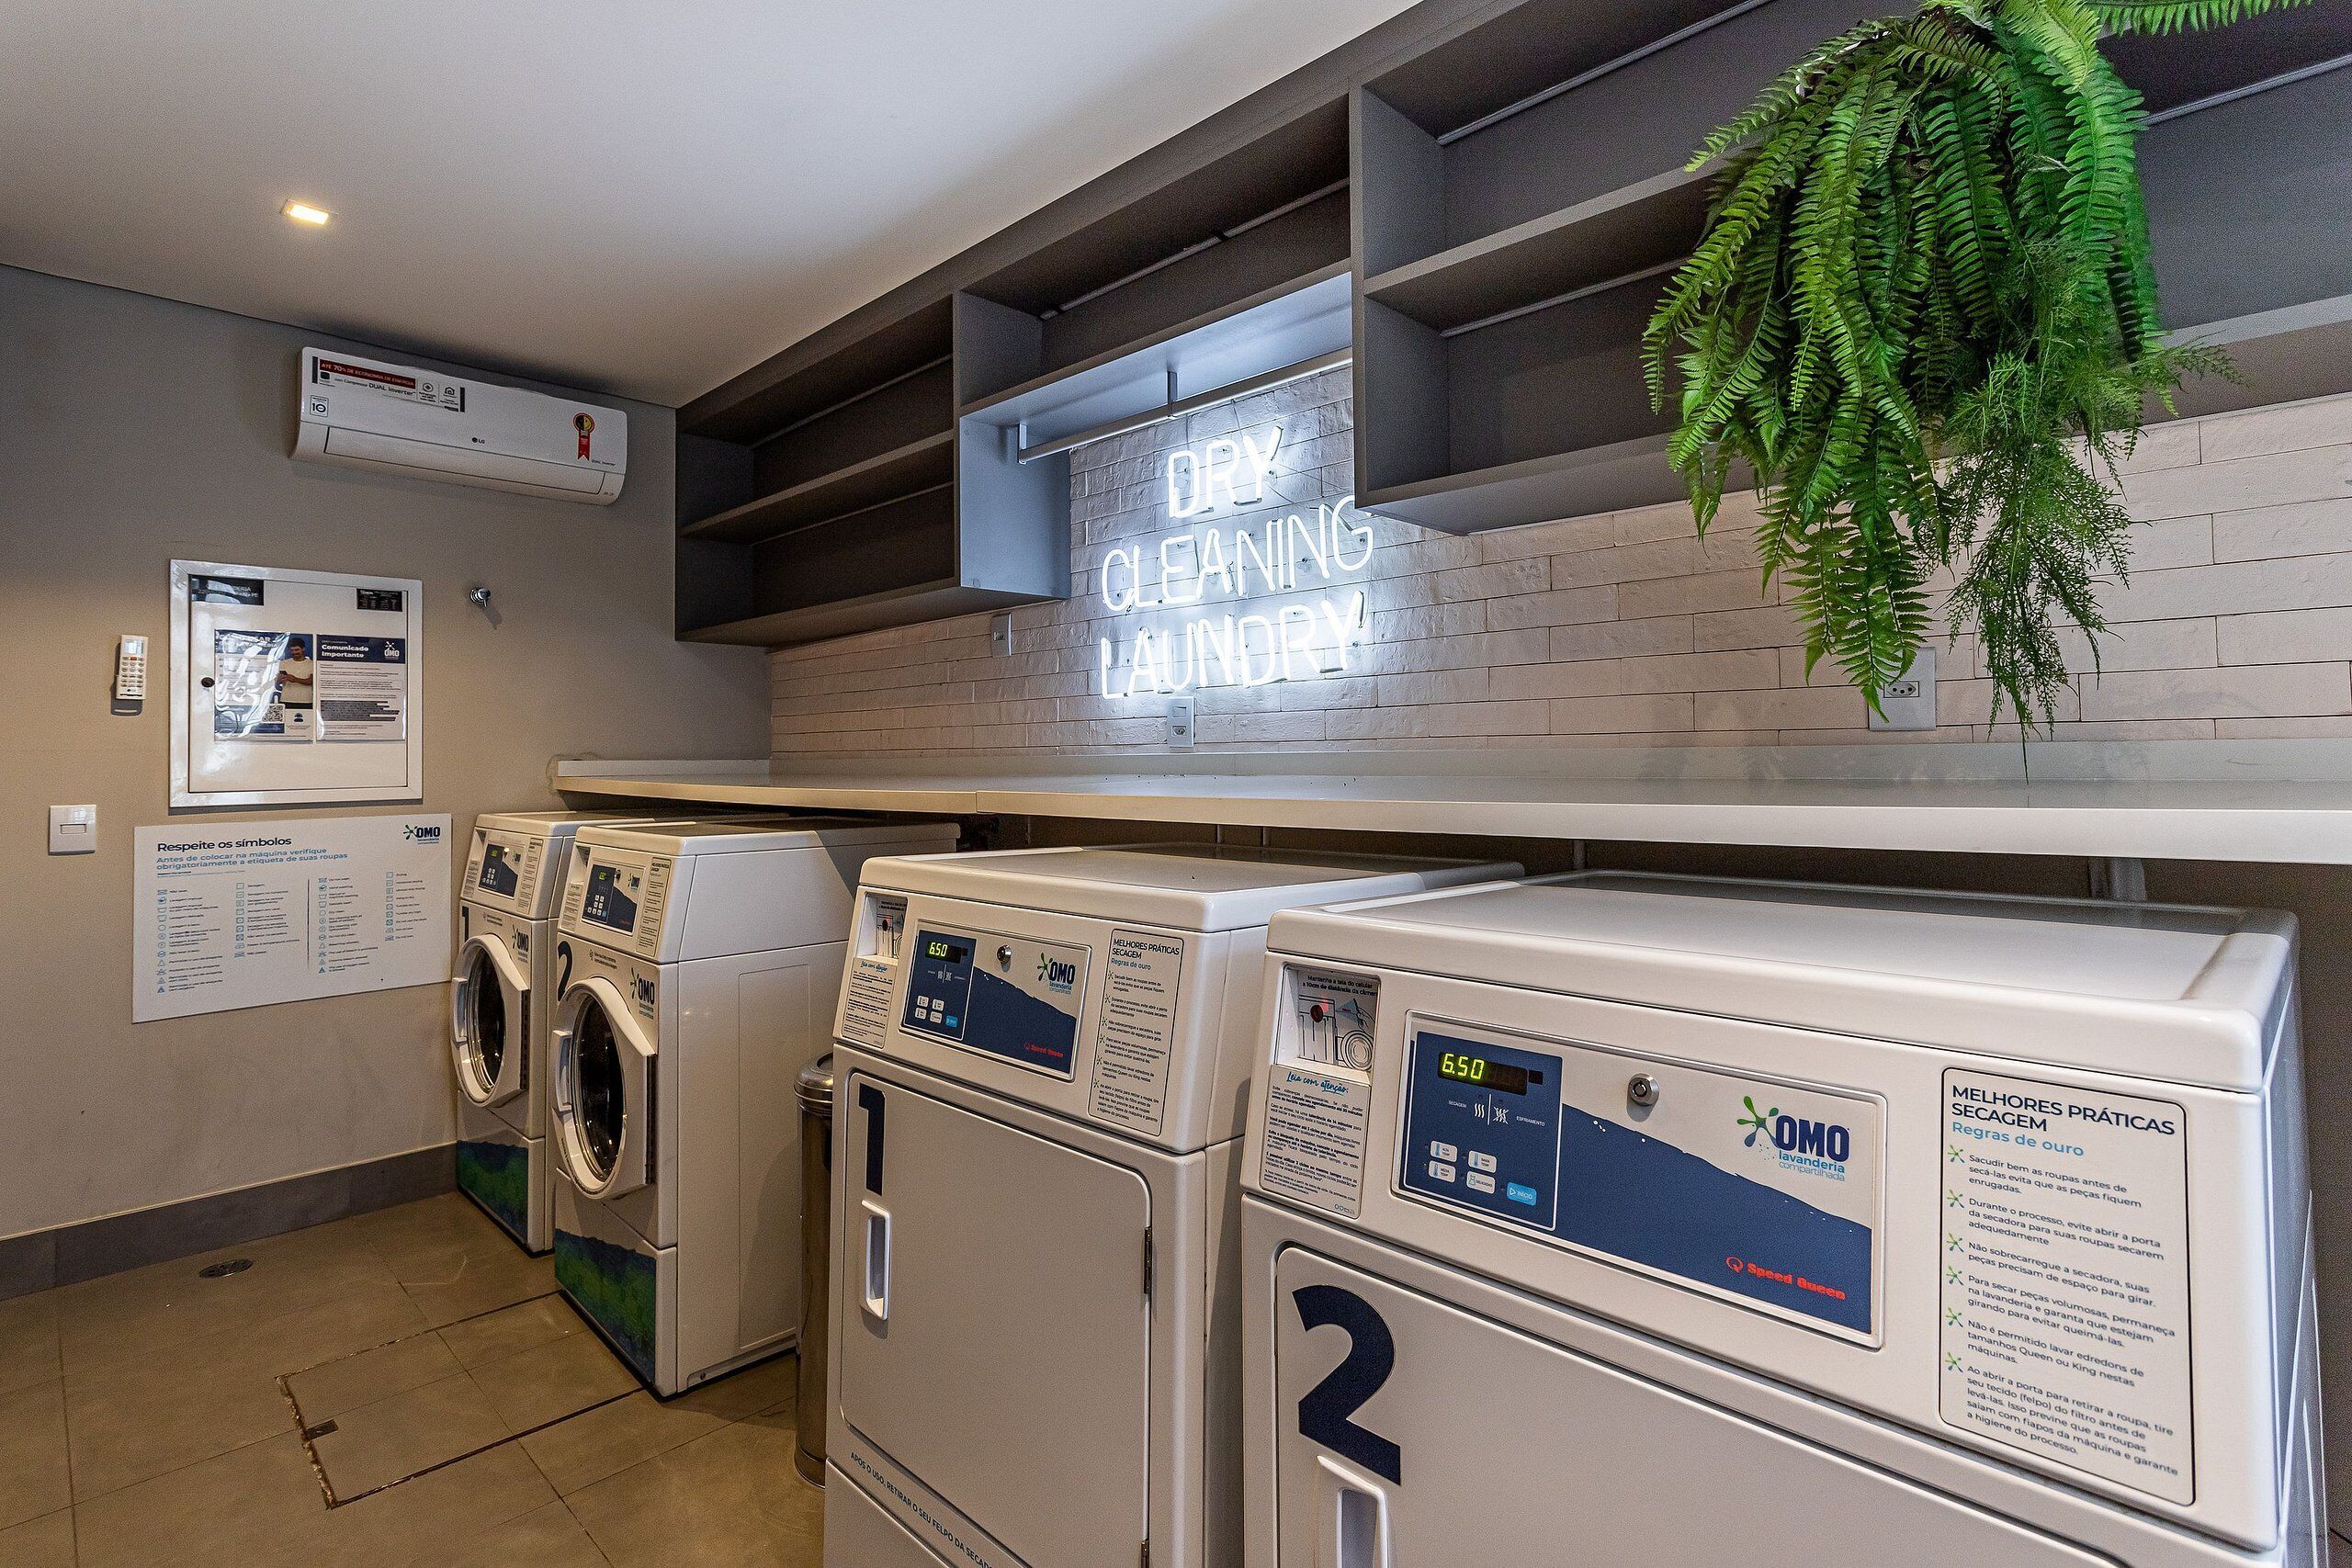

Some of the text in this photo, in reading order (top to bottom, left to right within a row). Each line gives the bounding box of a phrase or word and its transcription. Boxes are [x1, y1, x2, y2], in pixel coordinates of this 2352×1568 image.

[368, 382, 387, 391] DUAL
[1167, 423, 1284, 519] DRY
[1102, 494, 1374, 613] CLEANING
[322, 644, 369, 652] Comunicado
[322, 651, 365, 660] Importante
[384, 649, 400, 658] OMO
[1101, 590, 1365, 700] LAUNDRY
[157, 837, 292, 852] Respeite os símbolos
[416, 826, 441, 838] OMO
[156, 855, 184, 863] Antes
[199, 852, 233, 861] colocar
[249, 849, 288, 859] máquina
[289, 847, 327, 856] verifique
[156, 859, 237, 871] obrigatoriamente
[247, 856, 284, 865] etiqueta
[320, 852, 348, 862] roupas
[1111, 957, 1130, 967] Regras
[1112, 947, 1142, 959] SECAGEM
[1114, 938, 1180, 955] MELHORES PRÁTICAS
[558, 941, 573, 1002] 2
[1048, 961, 1076, 985] OMO
[638, 977, 655, 1005] OMO
[1286, 1071, 1302, 1084] Leia
[1303, 1077, 1319, 1087] com
[1442, 1052, 1485, 1081] 6.50
[1951, 1102, 2046, 1132] SECAGEM
[1952, 1085, 2175, 1135] MELHORES PRÁTICAS
[858, 1082, 886, 1197] 1
[1775, 1114, 1849, 1163] OMO
[1952, 1121, 2084, 1156] Regras de ouro
[1778, 1160, 1846, 1182] compartilhada
[1779, 1149, 1846, 1174] lavanderia
[1968, 1154, 2005, 1168] Sacudir
[2007, 1161, 2029, 1173] bem
[2044, 1171, 2079, 1183] roupas
[2082, 1179, 2110, 1190] antes
[2112, 1183, 2127, 1192] de
[1968, 1176, 2021, 1193] enrugadas.
[1969, 1166, 2006, 1179] secá-las
[2007, 1175, 2031, 1184] evita
[2033, 1179, 2053, 1189] que
[2069, 1187, 2100, 1199] peças
[2102, 1192, 2141, 1208] fiquem
[1968, 1209, 2164, 1260] da secadora para suas roupas secarem
[1969, 1197, 2007, 1213] Durante
[2018, 1210, 2064, 1226] processo,
[2066, 1221, 2092, 1232] evite
[2094, 1227, 2119, 1237] abrir
[2131, 1235, 2160, 1247] porta
[1747, 1262, 1792, 1285] Speed
[1968, 1241, 1987, 1252] Não
[1989, 1247, 2061, 1270] sobrecarregue
[2072, 1269, 2122, 1287] secadora,
[2124, 1281, 2150, 1293] suas
[1968, 1254, 2155, 1307] peças precisam de espaço para girar.
[1967, 1298, 2124, 1348] girando para evitar queimá-las.
[1968, 1274, 2175, 1337] Para secar peças volumosas, permaneça
[1968, 1287, 1979, 1295] na
[1982, 1289, 2032, 1309] lavanderia
[2043, 1308, 2083, 1324] garanta
[2086, 1319, 2107, 1330] que
[2109, 1325, 2154, 1343] estejam
[1967, 1319, 2143, 1377] Não é permitido lavar edredons de
[1967, 1343, 2018, 1364] máquinas.
[1967, 1331, 2134, 1386] tamanhos Queen ou King nestas
[1292, 1284, 1402, 1487] 2
[1966, 1365, 1982, 1374] Ao
[1982, 1371, 2005, 1382] abrir
[2016, 1382, 2042, 1394] porta
[2045, 1391, 2068, 1403] para
[2072, 1399, 2104, 1413] retirar
[2116, 1413, 2151, 1430] roupa,
[2154, 1424, 2173, 1436] tire
[866, 1465, 872, 1473] O
[887, 1481, 911, 1507] RETIRAR
[912, 1503, 919, 1513] O
[918, 1507, 932, 1524] SEU
[932, 1518, 954, 1542] FELPO
[955, 1537, 965, 1551] DA
